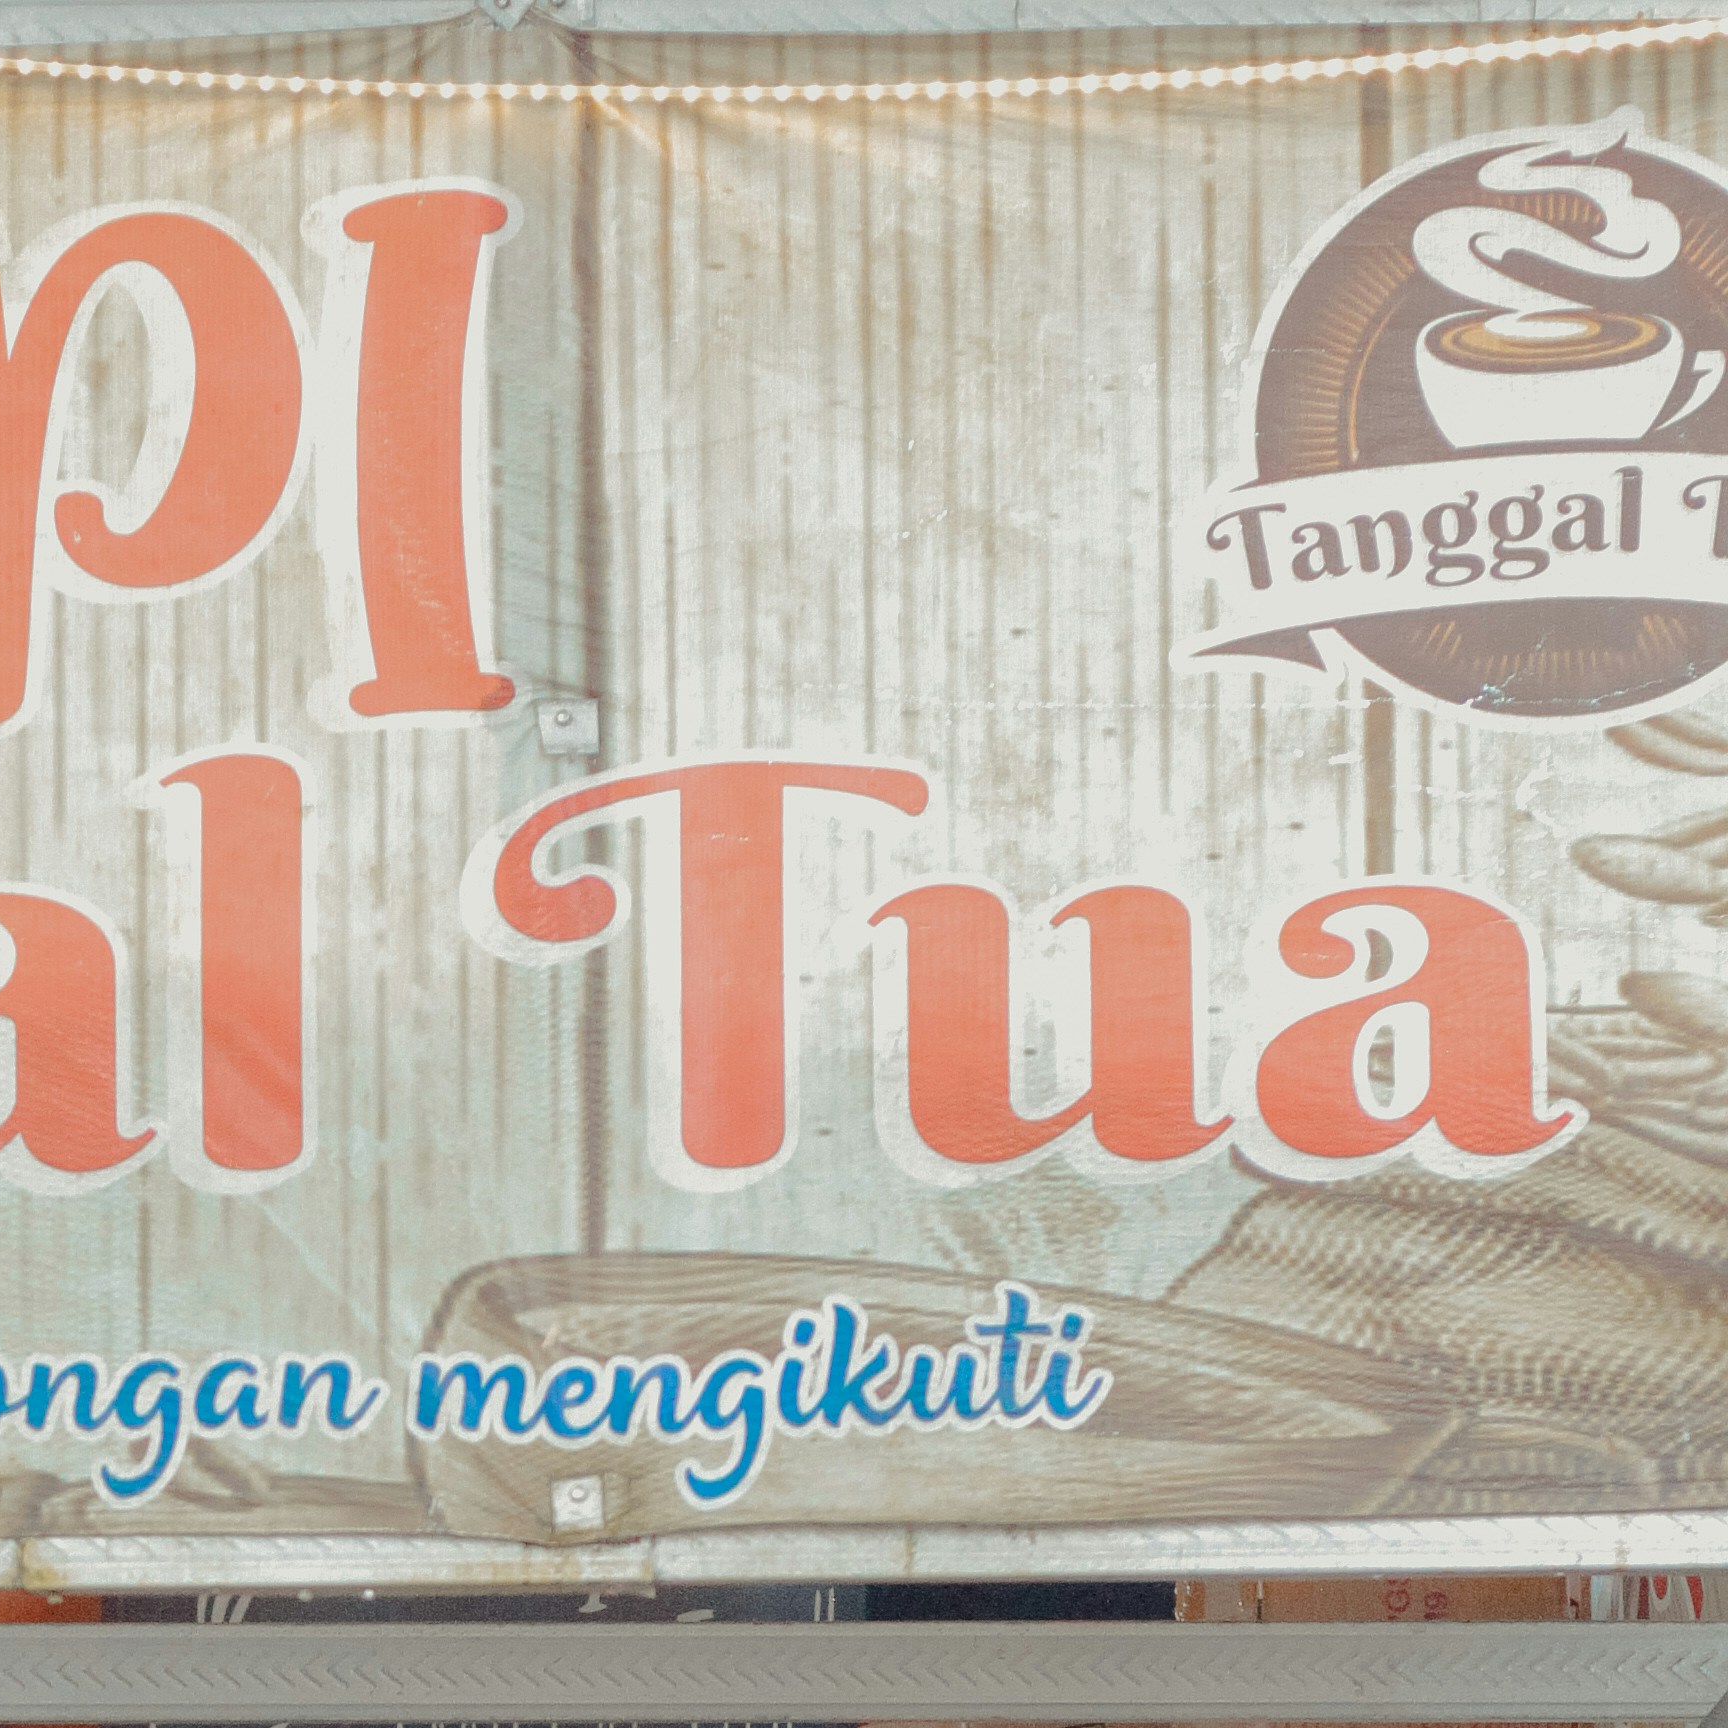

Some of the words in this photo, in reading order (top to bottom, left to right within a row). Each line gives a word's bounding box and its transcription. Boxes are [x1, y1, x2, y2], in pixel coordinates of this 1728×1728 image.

[1207, 466, 1643, 591] Tanggal
[493, 760, 1575, 1168] Tua
[414, 1291, 1103, 1501] mengikuti
